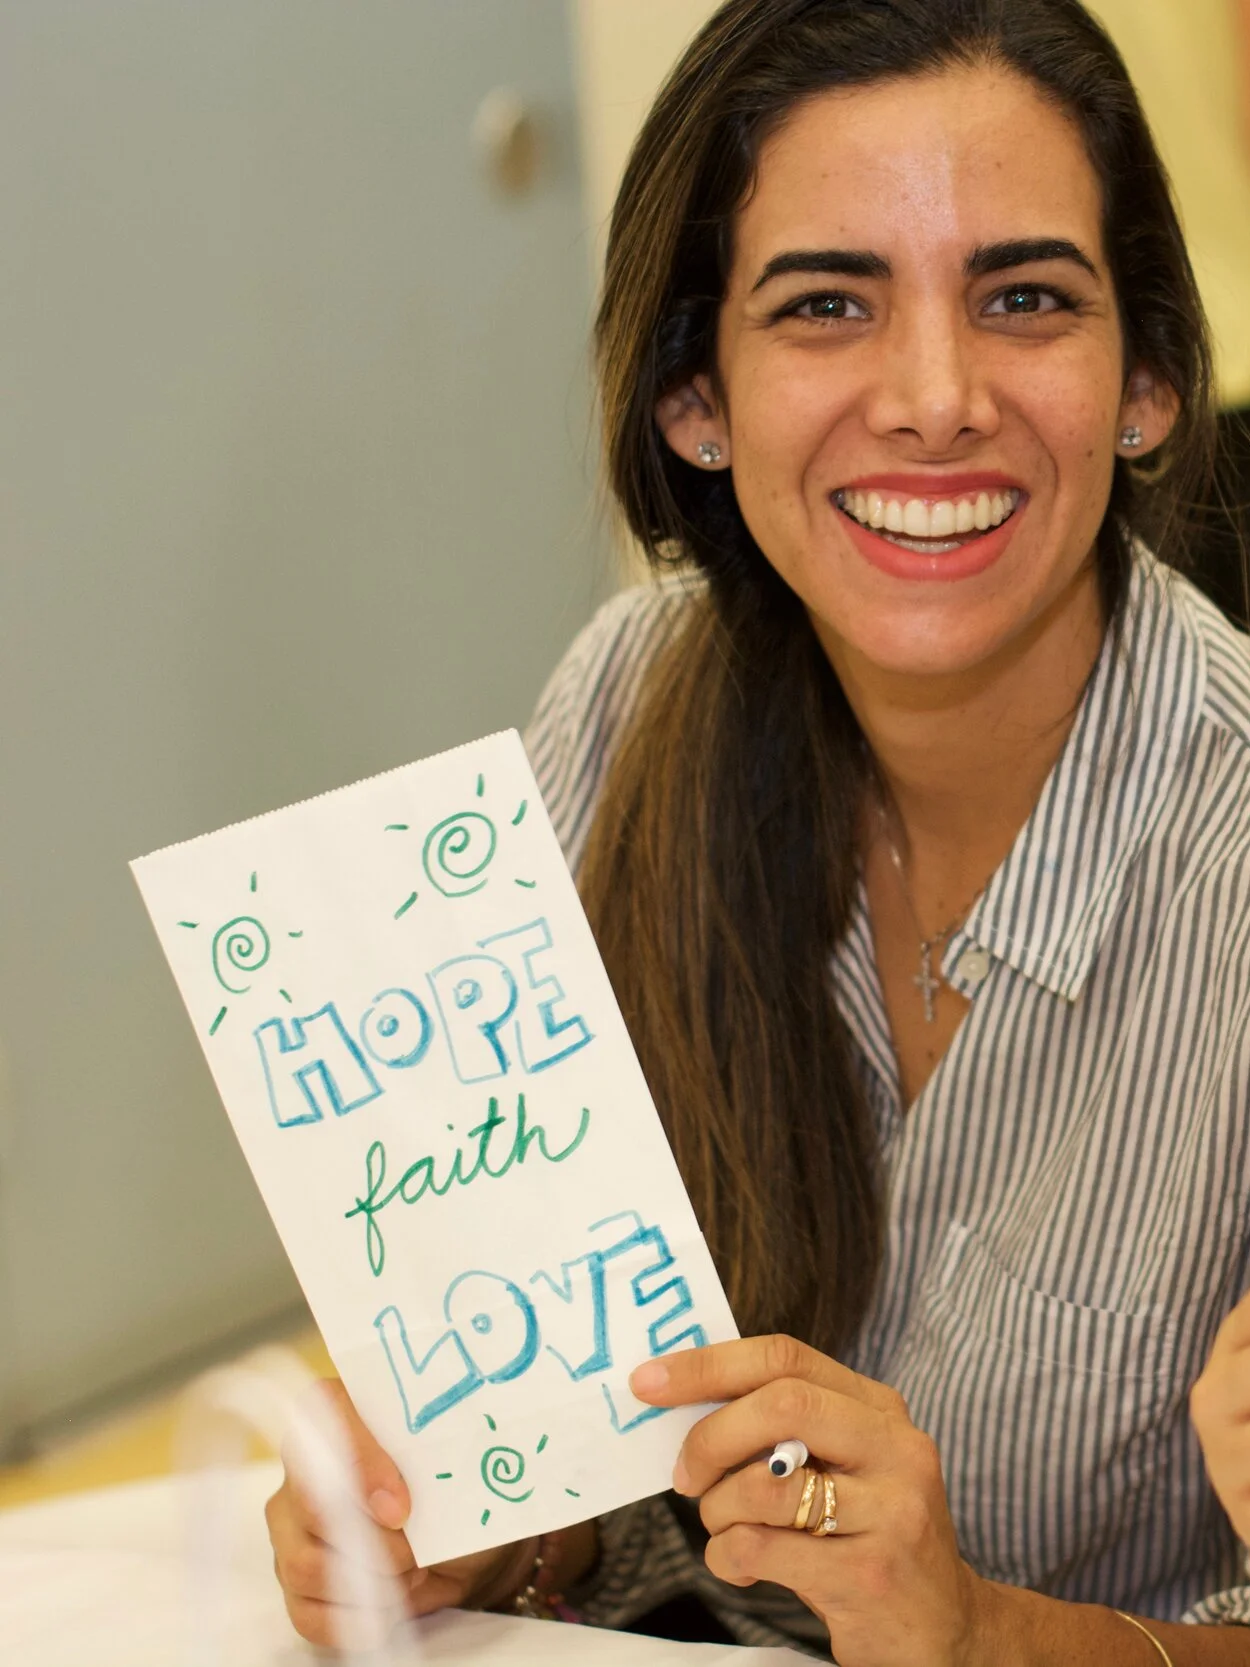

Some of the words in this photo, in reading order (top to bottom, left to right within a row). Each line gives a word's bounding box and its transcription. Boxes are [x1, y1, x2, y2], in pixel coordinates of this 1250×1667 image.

[253, 916, 596, 1128] HOPE
[344, 1092, 591, 1277] faith
[373, 1210, 712, 1435] LOVE
